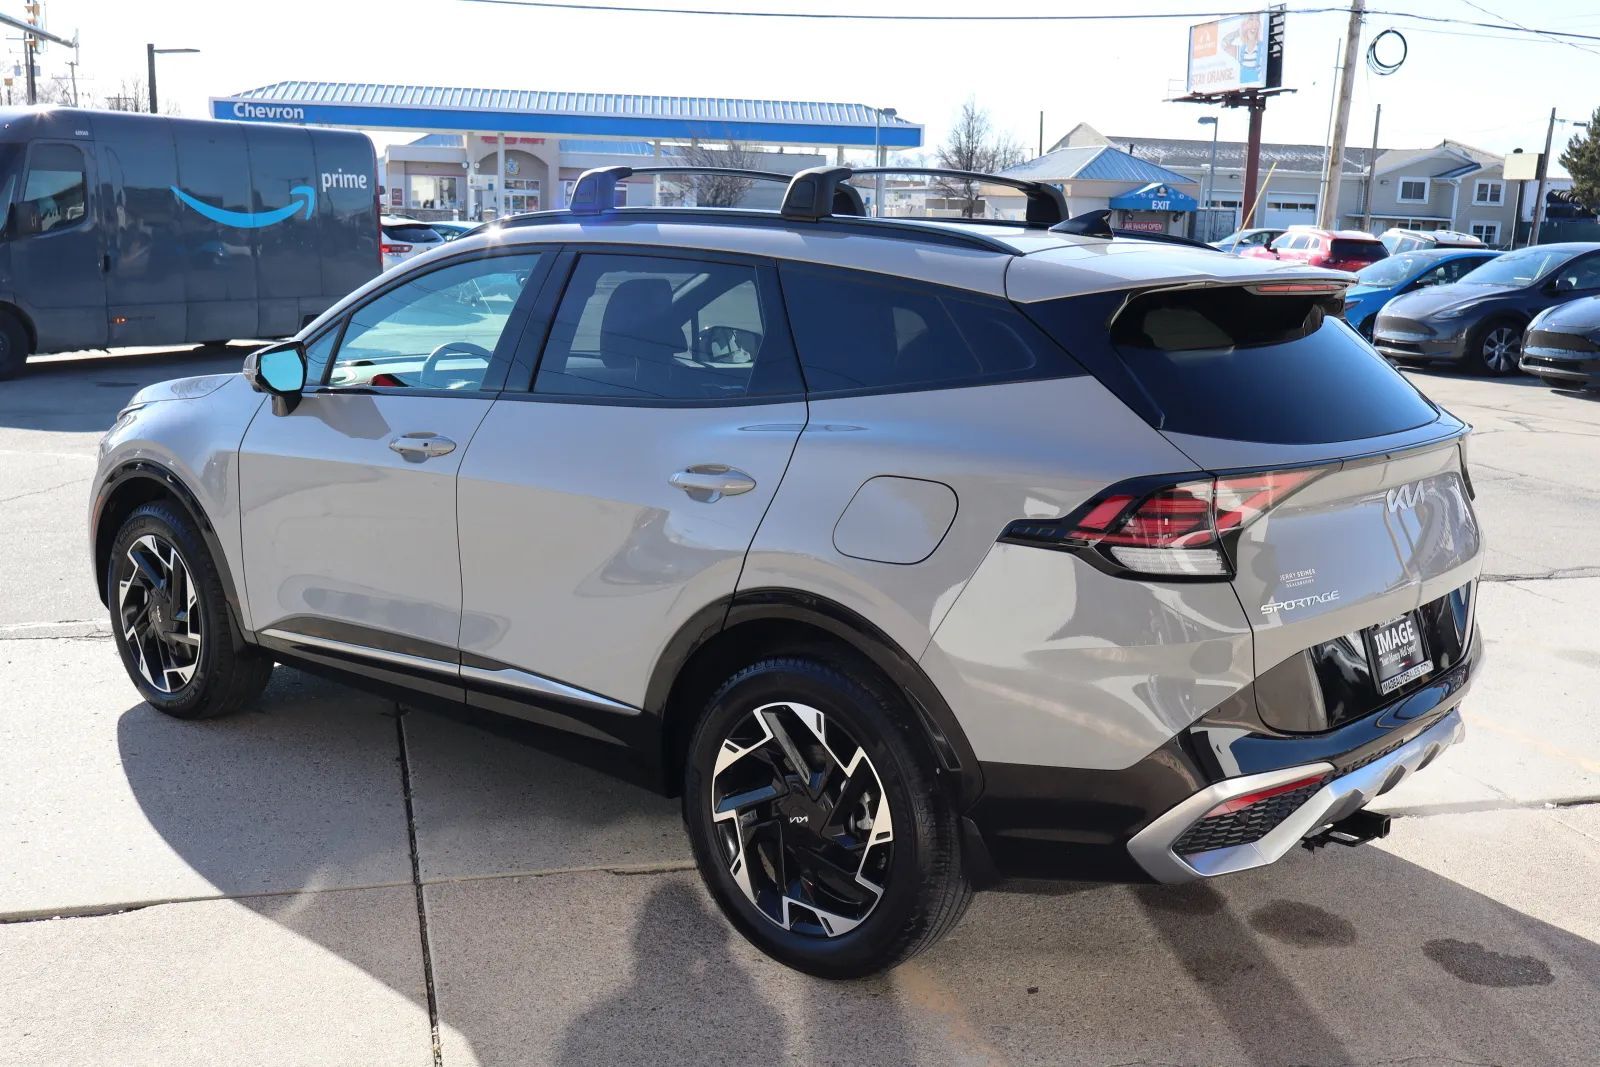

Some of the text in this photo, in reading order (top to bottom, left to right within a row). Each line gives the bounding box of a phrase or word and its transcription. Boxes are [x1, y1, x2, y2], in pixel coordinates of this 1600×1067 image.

[233, 102, 304, 119] Chevron
[321, 168, 367, 192] prime
[1151, 200, 1171, 210] EXIT
[1148, 223, 1163, 231] OPEN
[1386, 480, 1425, 513] KIA
[1260, 590, 1340, 614] SPORTAGE
[1374, 620, 1416, 656] IMAGE
